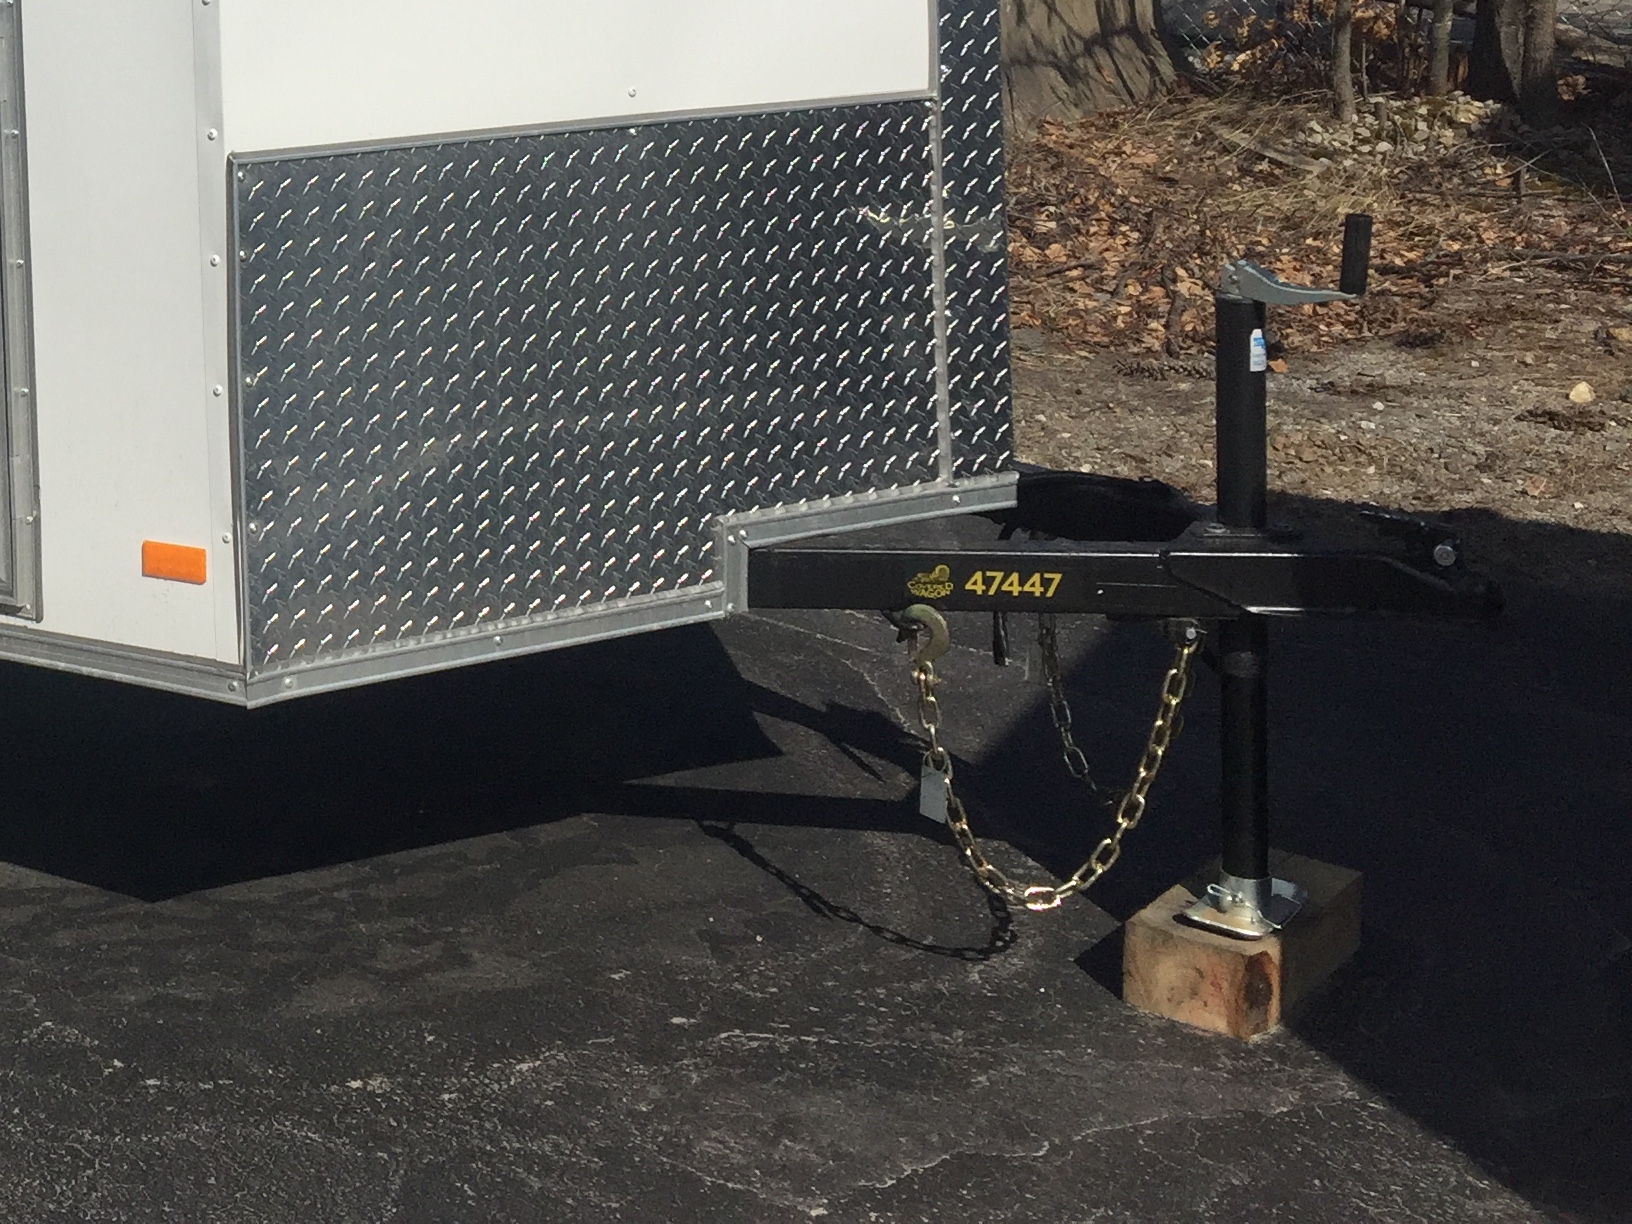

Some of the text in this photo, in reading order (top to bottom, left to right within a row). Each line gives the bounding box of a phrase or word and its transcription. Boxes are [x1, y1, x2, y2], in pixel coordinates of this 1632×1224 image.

[907, 581, 954, 592] COVERED
[964, 571, 1063, 598] 47447
[910, 588, 952, 599] WAGON
